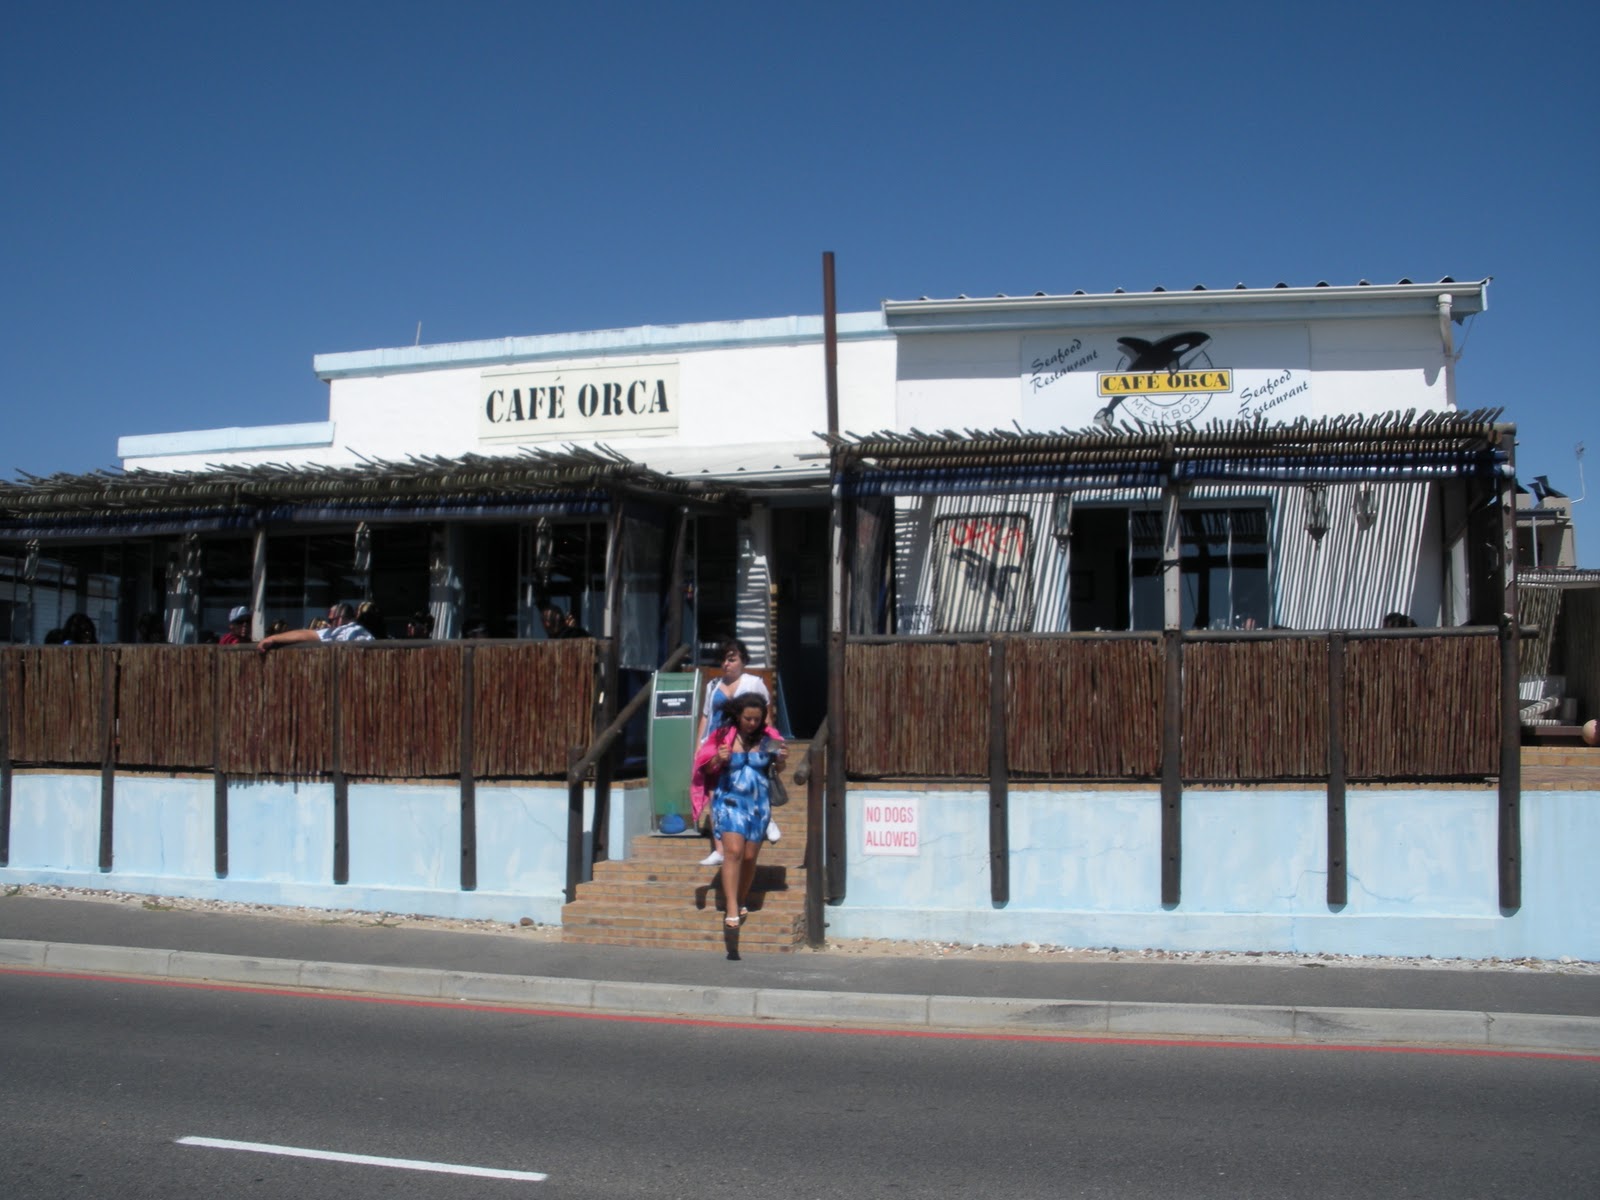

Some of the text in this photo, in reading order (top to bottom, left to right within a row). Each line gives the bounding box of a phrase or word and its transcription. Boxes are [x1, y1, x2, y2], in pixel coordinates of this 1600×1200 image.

[1029, 349, 1098, 394] Restaurant
[1031, 338, 1082, 377] Seafood
[486, 376, 670, 423] CAFÉ ORCA
[1167, 372, 1228, 388] ORCA
[1239, 369, 1292, 408] Seafood
[1131, 396, 1201, 421] MELKBOS
[1237, 380, 1309, 422] Restaurant
[866, 806, 914, 823] NO DOGS
[865, 830, 917, 848] ALLOWED
